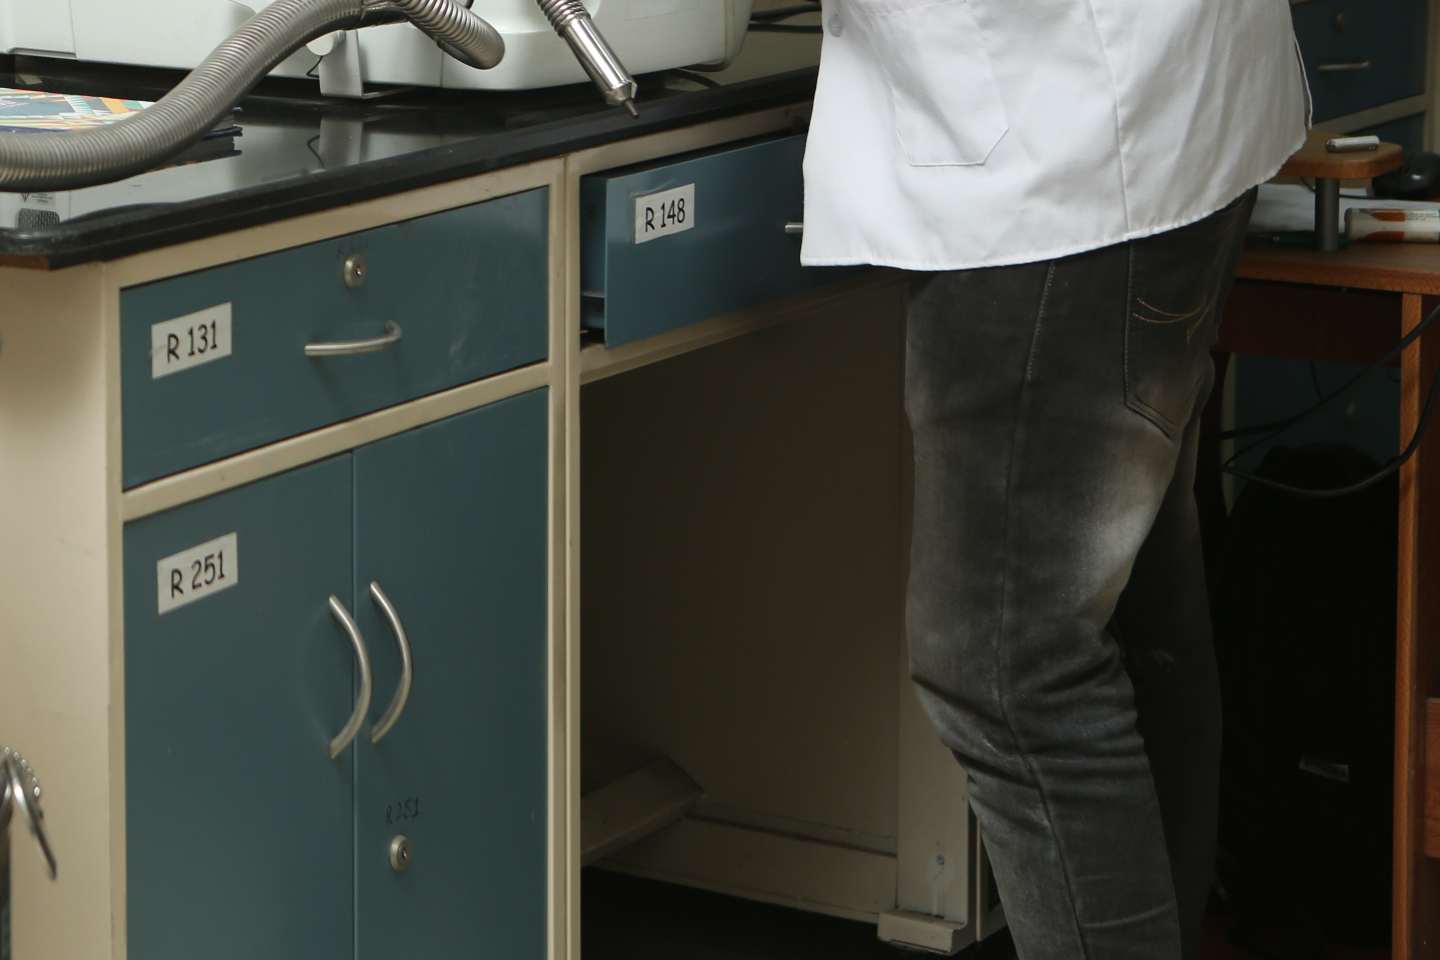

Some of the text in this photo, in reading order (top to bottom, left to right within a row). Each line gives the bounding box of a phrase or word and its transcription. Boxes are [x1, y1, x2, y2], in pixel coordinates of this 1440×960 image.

[645, 198, 686, 232] R 148
[167, 320, 218, 364] R 131
[171, 550, 225, 599] R 251
